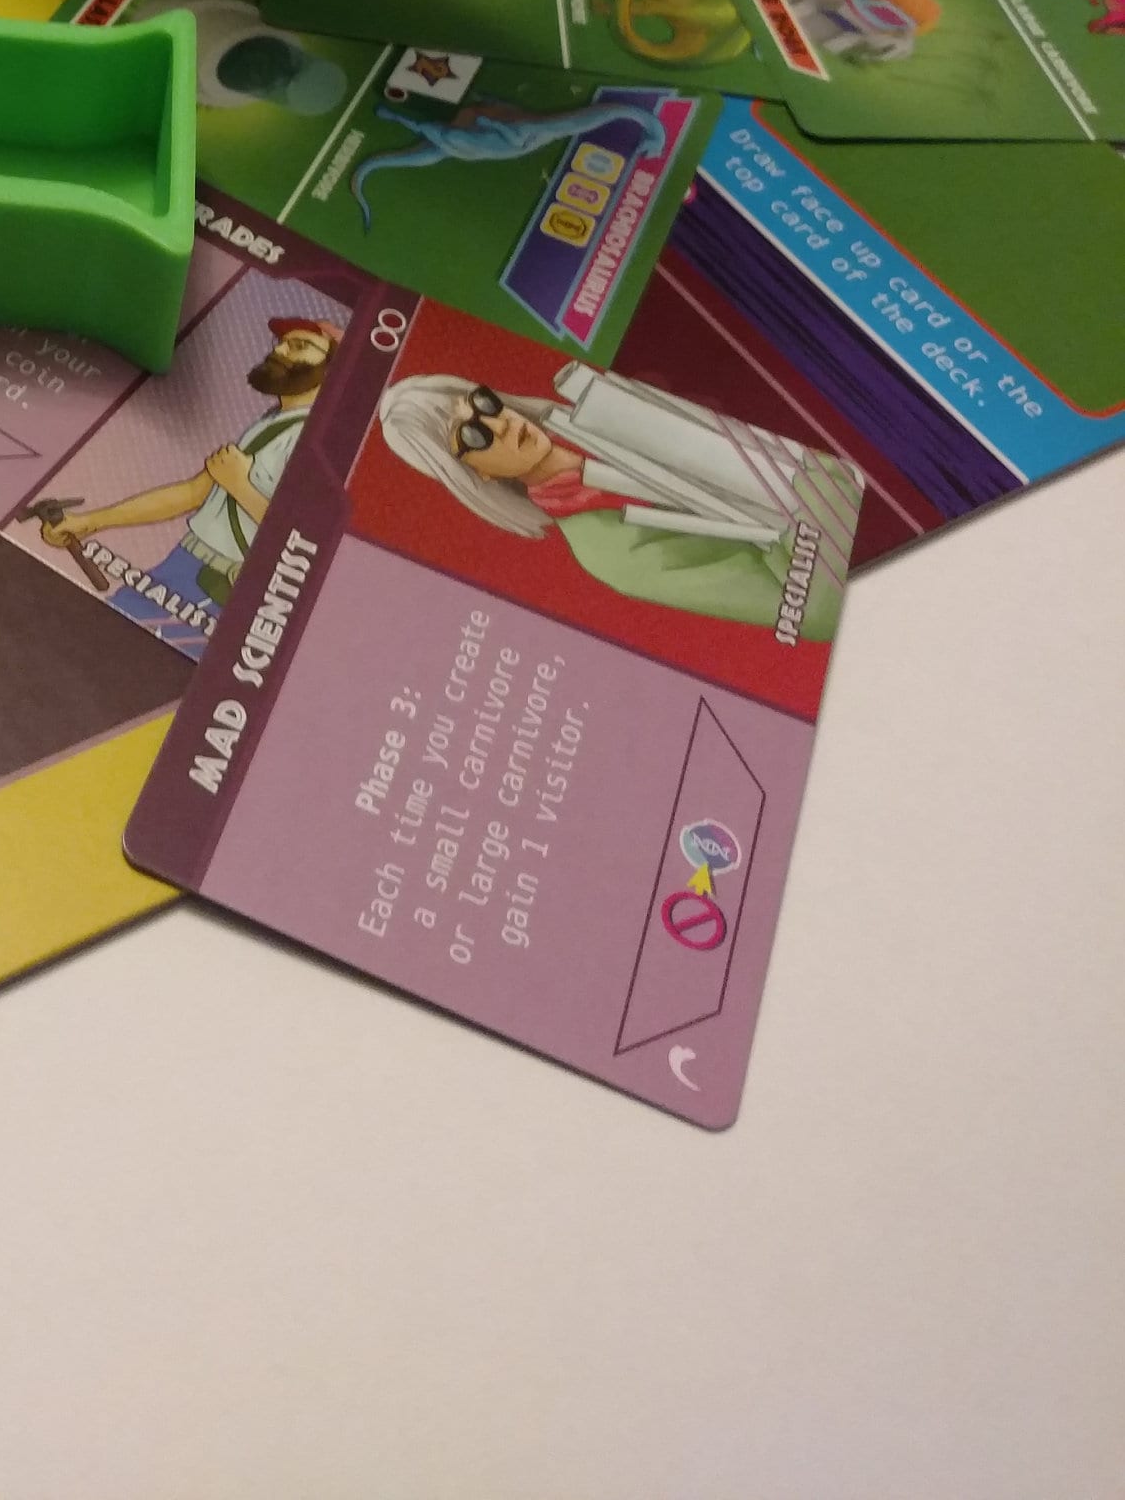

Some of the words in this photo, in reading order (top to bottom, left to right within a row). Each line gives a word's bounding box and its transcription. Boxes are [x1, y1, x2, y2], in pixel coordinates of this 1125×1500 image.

[195, 200, 285, 264] RADES
[574, 168, 655, 317] BRACHIOSAURUS
[725, 156, 764, 192] top
[771, 200, 830, 250] card
[831, 257, 867, 281] of
[871, 292, 913, 334] the
[921, 342, 985, 407] deck.
[730, 128, 786, 177] Draw
[791, 185, 843, 233] face
[851, 241, 881, 268] up
[889, 277, 951, 328] card
[954, 337, 988, 363] or
[997, 374, 1043, 418] the
[6, 351, 65, 394] coin
[36, 338, 101, 378] your
[775, 520, 820, 647] SPECIALIST
[189, 699, 247, 795] MAD
[232, 528, 318, 688] SCIENTIST
[498, 655, 565, 807] carnivore,
[355, 729, 406, 816] Phase
[390, 686, 422, 720] 3:
[358, 862, 405, 938] Each
[390, 778, 433, 845] time
[422, 713, 455, 769] you
[445, 609, 490, 703] create
[414, 905, 436, 929] a
[426, 805, 470, 893] small
[459, 646, 520, 790] carnivore
[501, 871, 539, 948] gain
[521, 837, 549, 858] 1
[536, 701, 589, 823] visitor.
[458, 820, 509, 907] large
[449, 923, 475, 965] or
